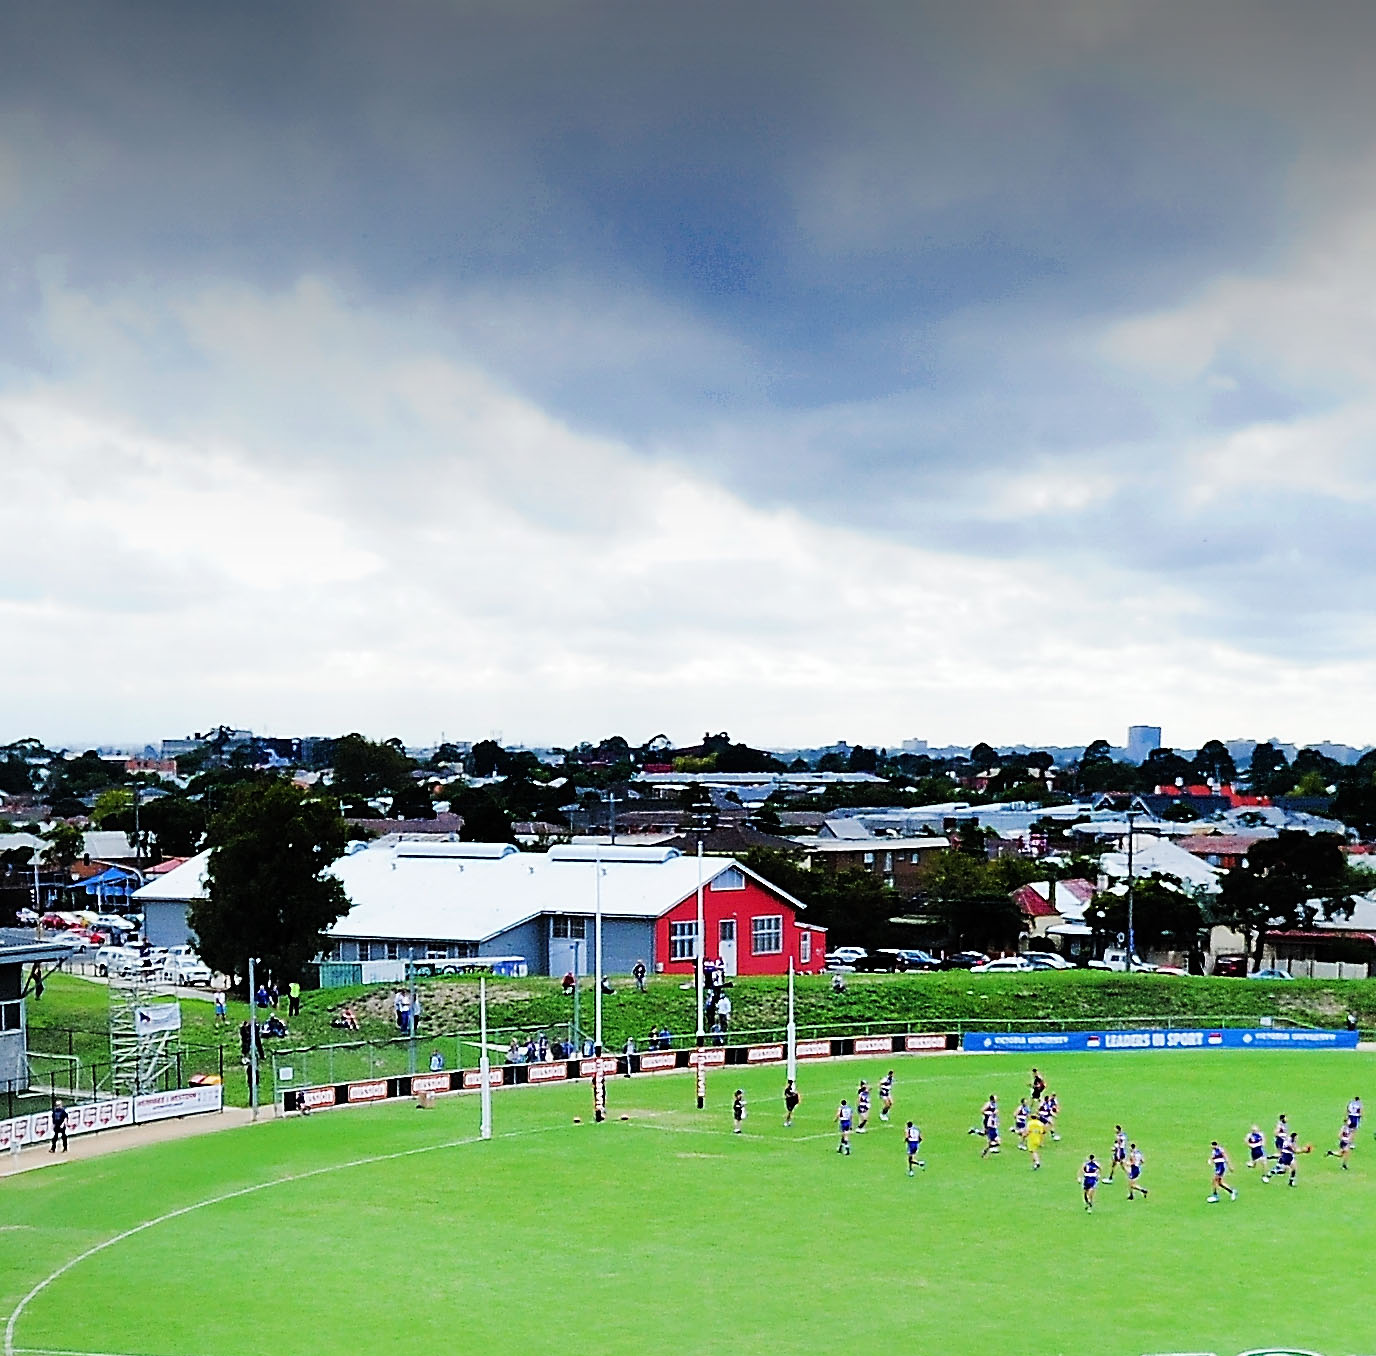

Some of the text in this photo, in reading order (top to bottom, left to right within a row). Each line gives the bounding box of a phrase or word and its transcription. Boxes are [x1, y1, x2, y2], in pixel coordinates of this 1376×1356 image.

[1105, 1032, 1204, 1048] LEADERS IN SPORT
